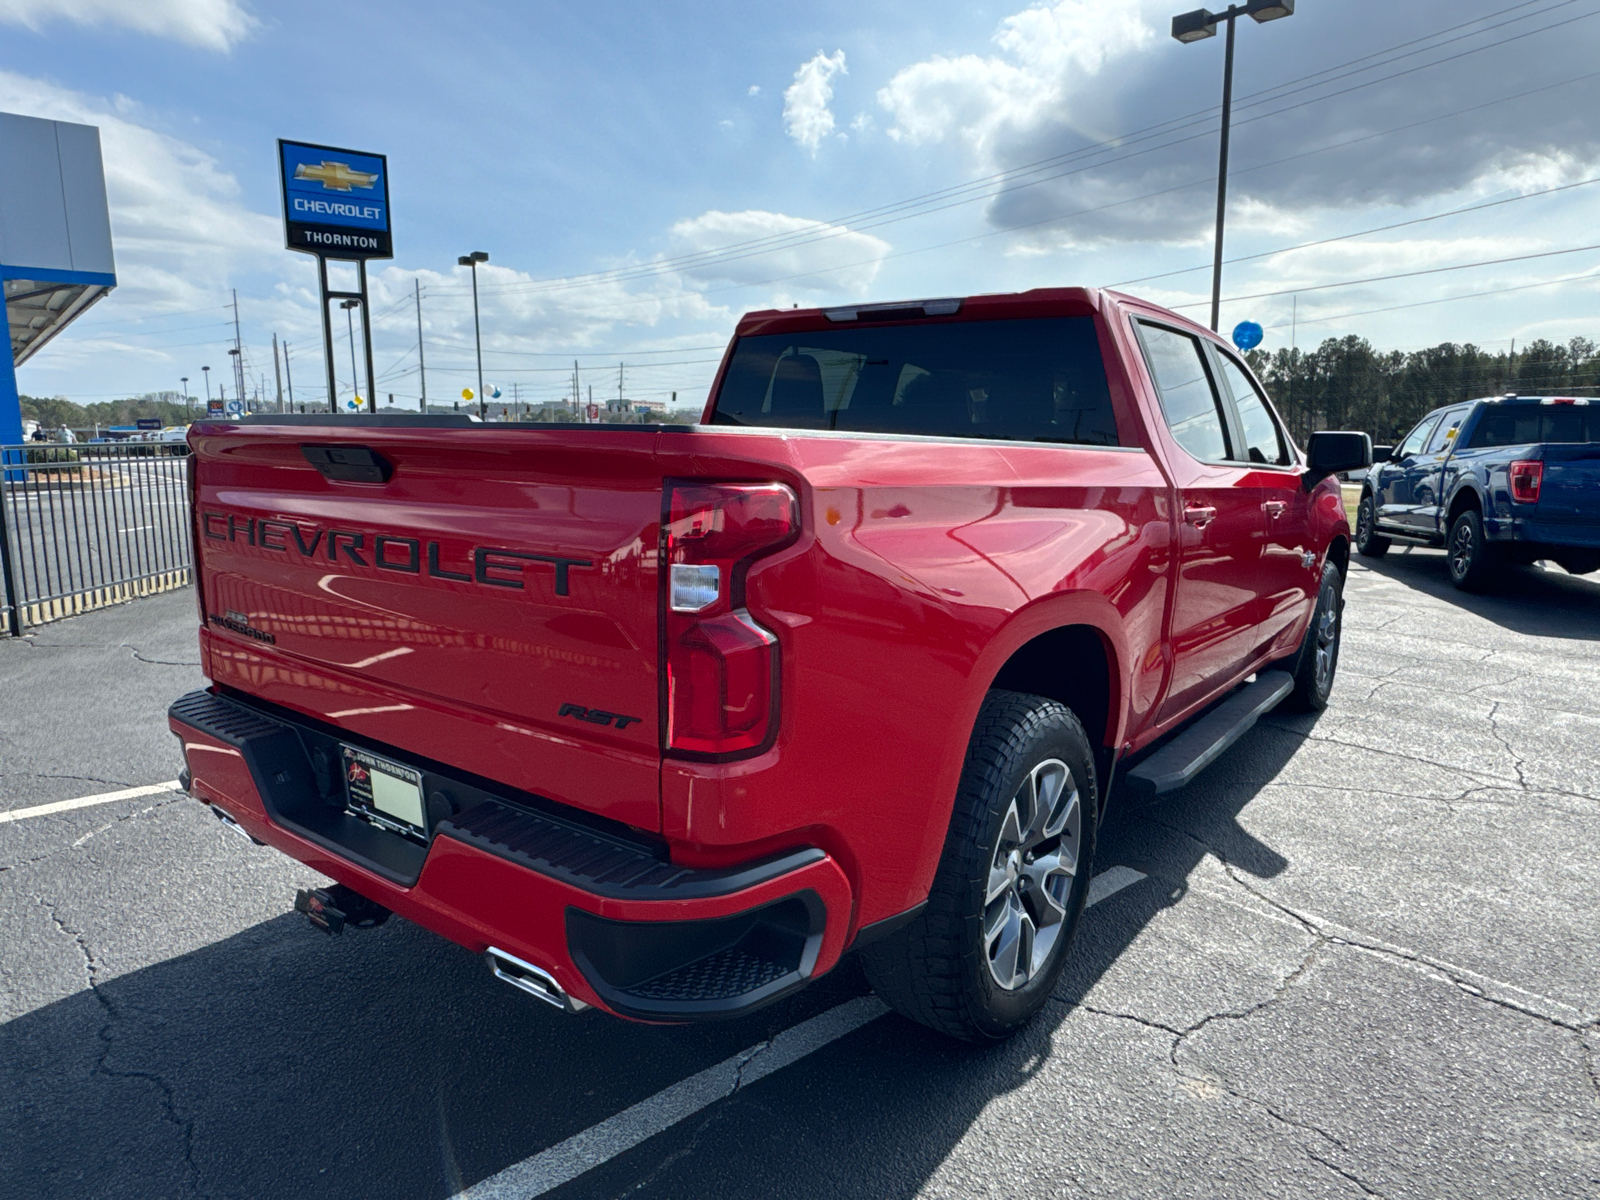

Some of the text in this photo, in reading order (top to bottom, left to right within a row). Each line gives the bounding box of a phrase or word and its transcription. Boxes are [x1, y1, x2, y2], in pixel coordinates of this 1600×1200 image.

[294, 198, 381, 219] CHEVROLET
[304, 231, 378, 248] THORNTON
[203, 511, 592, 597] CHEVROLET
[558, 702, 642, 729] RST
[357, 752, 376, 766] JOHN
[376, 759, 417, 782] THORNTON
